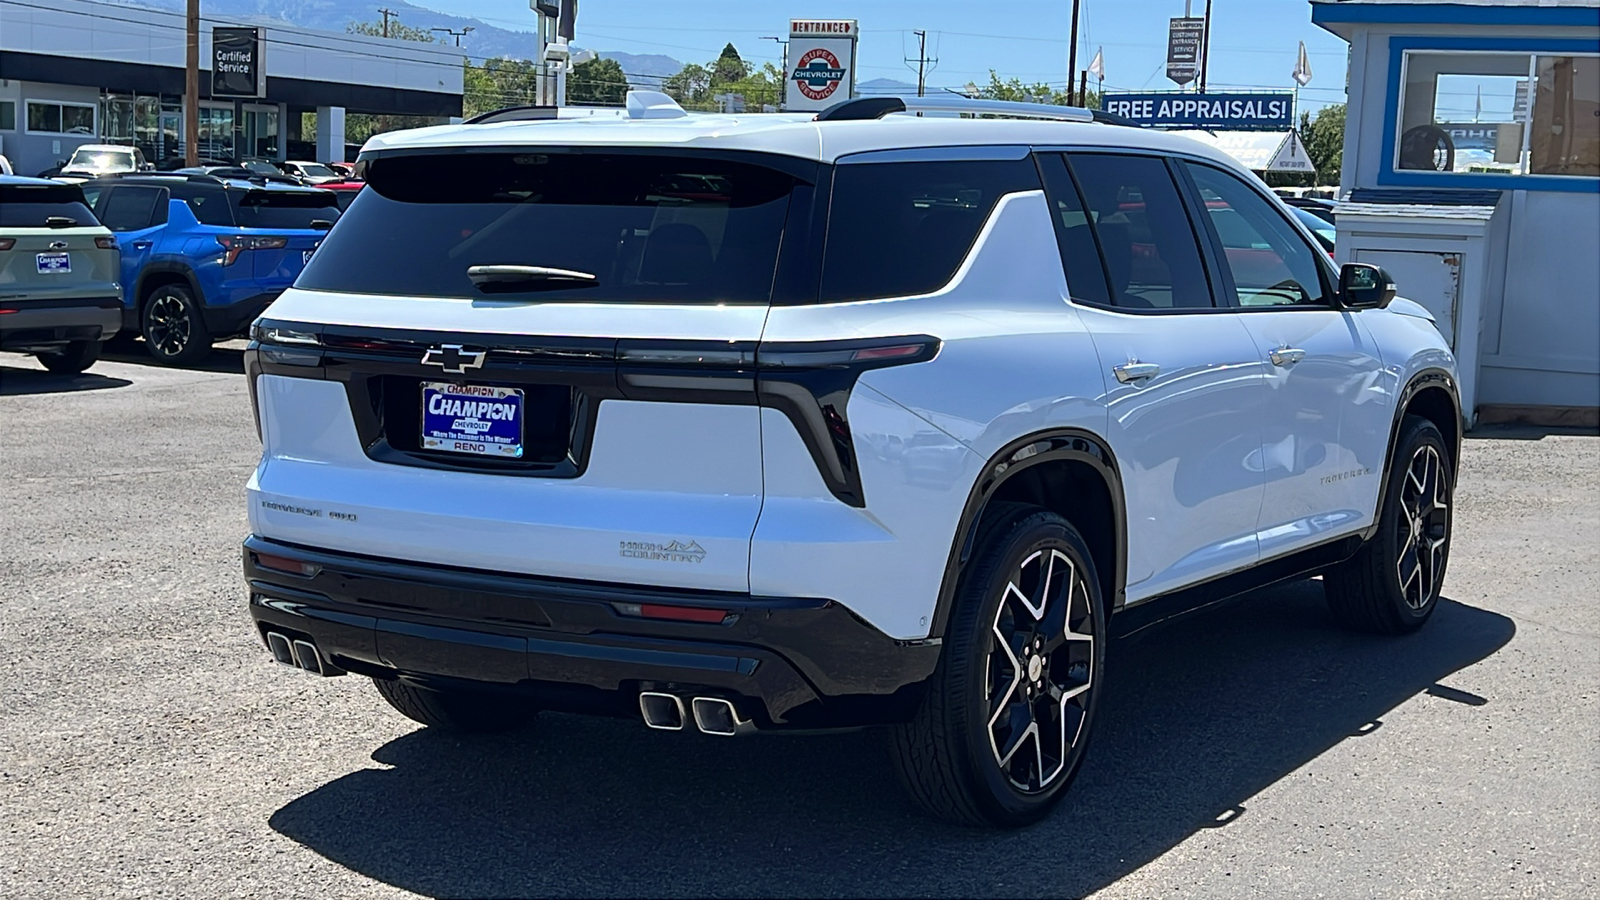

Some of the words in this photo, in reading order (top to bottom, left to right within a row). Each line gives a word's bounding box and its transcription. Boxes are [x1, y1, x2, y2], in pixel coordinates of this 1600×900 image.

[798, 22, 844, 33] ENTRANCE
[216, 50, 252, 62] Certified
[803, 50, 835, 63] SUPER
[218, 61, 249, 73] Service
[800, 82, 836, 99] SERVICE
[1107, 100, 1153, 119] FREE
[1157, 100, 1286, 119] APPRAISALS!
[447, 385, 495, 396] CHAMPION
[429, 394, 516, 421] CHAMPION
[454, 420, 489, 430] CHEVROLET
[448, 431, 457, 439] The
[457, 433, 479, 441] Customer
[454, 442, 486, 452] RENO
[261, 500, 323, 518] TRAVERSE
[328, 511, 358, 522] AWD
[619, 541, 664, 551] HIGH
[619, 551, 705, 563] COUNTRY
